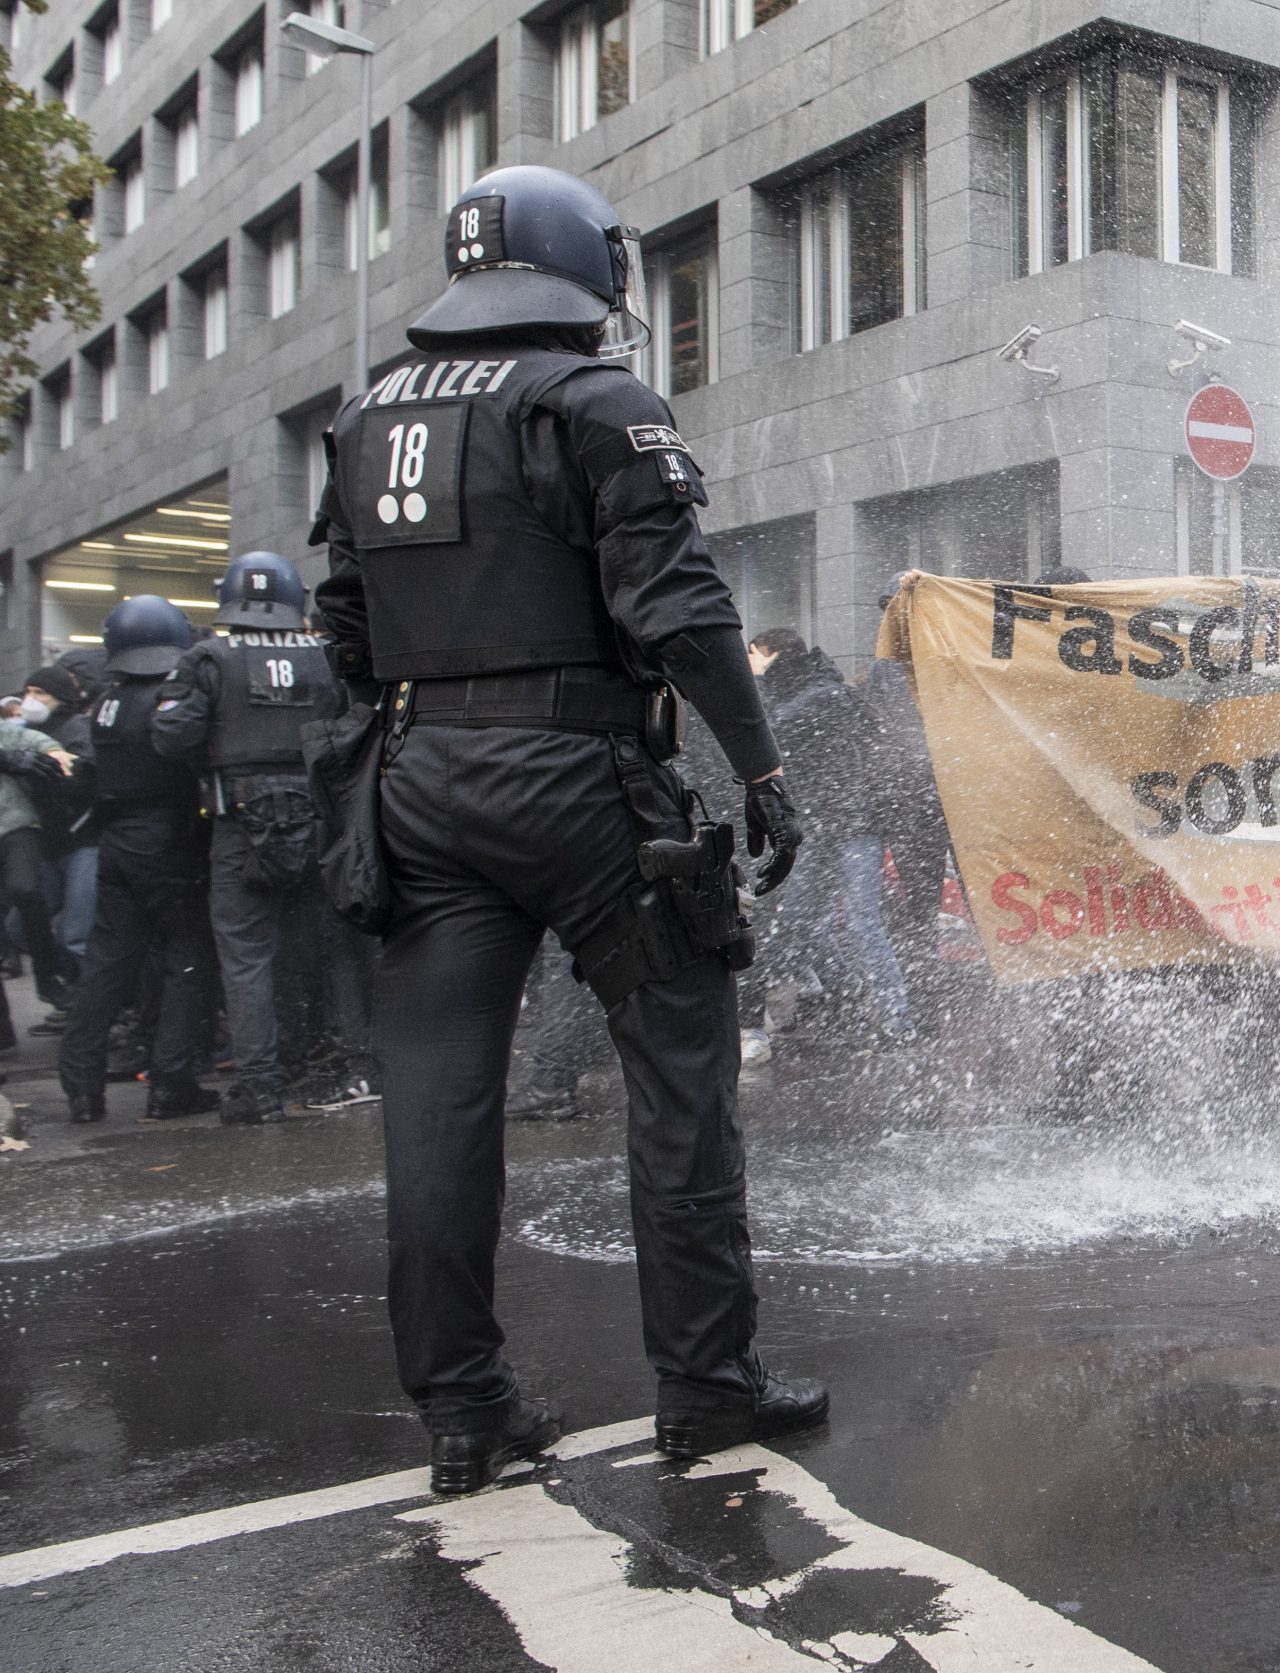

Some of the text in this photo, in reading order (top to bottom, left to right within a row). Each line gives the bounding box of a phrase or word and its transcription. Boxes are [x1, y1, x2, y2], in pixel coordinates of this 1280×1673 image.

[459, 207, 480, 241] 18
[360, 359, 519, 409] POLIZEI
[387, 422, 429, 489] 18
[664, 454, 680, 471] 18
[251, 574, 268, 590] 18
[227, 631, 319, 648] POLIZEI
[265, 659, 295, 688] 18
